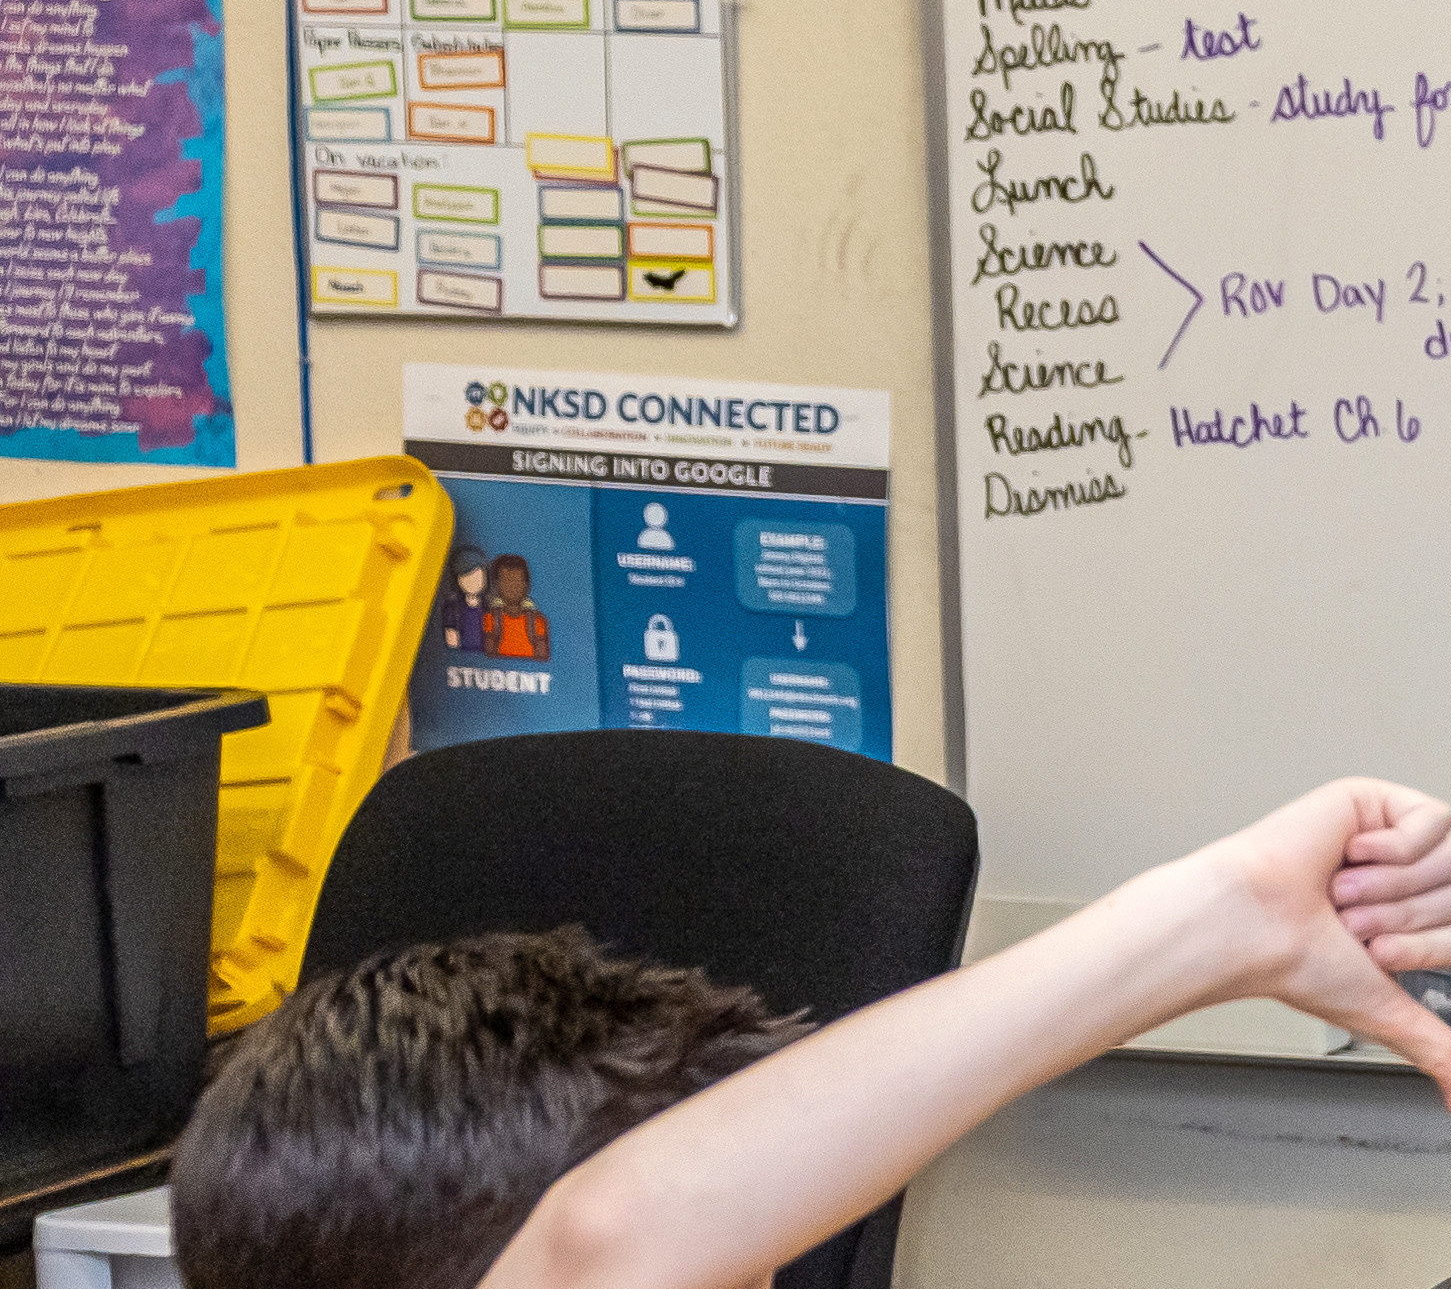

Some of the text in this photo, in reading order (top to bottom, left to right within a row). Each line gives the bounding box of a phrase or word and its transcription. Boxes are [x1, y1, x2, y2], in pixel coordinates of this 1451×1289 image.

[972, 12, 1262, 90] Spelling test
[966, 81, 1078, 142] Social
[1100, 77, 1238, 130] Studies
[1270, 73, 1395, 141] study
[970, 148, 1115, 215] Lunch
[971, 223, 1118, 286] Science
[995, 282, 1120, 331] Recess
[1311, 272, 1386, 323] Day
[978, 340, 1124, 399] Science
[512, 386, 840, 435] NKSD CONNECTED
[984, 411, 1134, 468] Reading
[1170, 401, 1308, 448] Hatchet
[1395, 399, 1421, 444] 6
[512, 450, 773, 487] SIGNING INTO GOOGLE
[984, 470, 1126, 519] Dismiss
[446, 666, 551, 695] STUDENT
